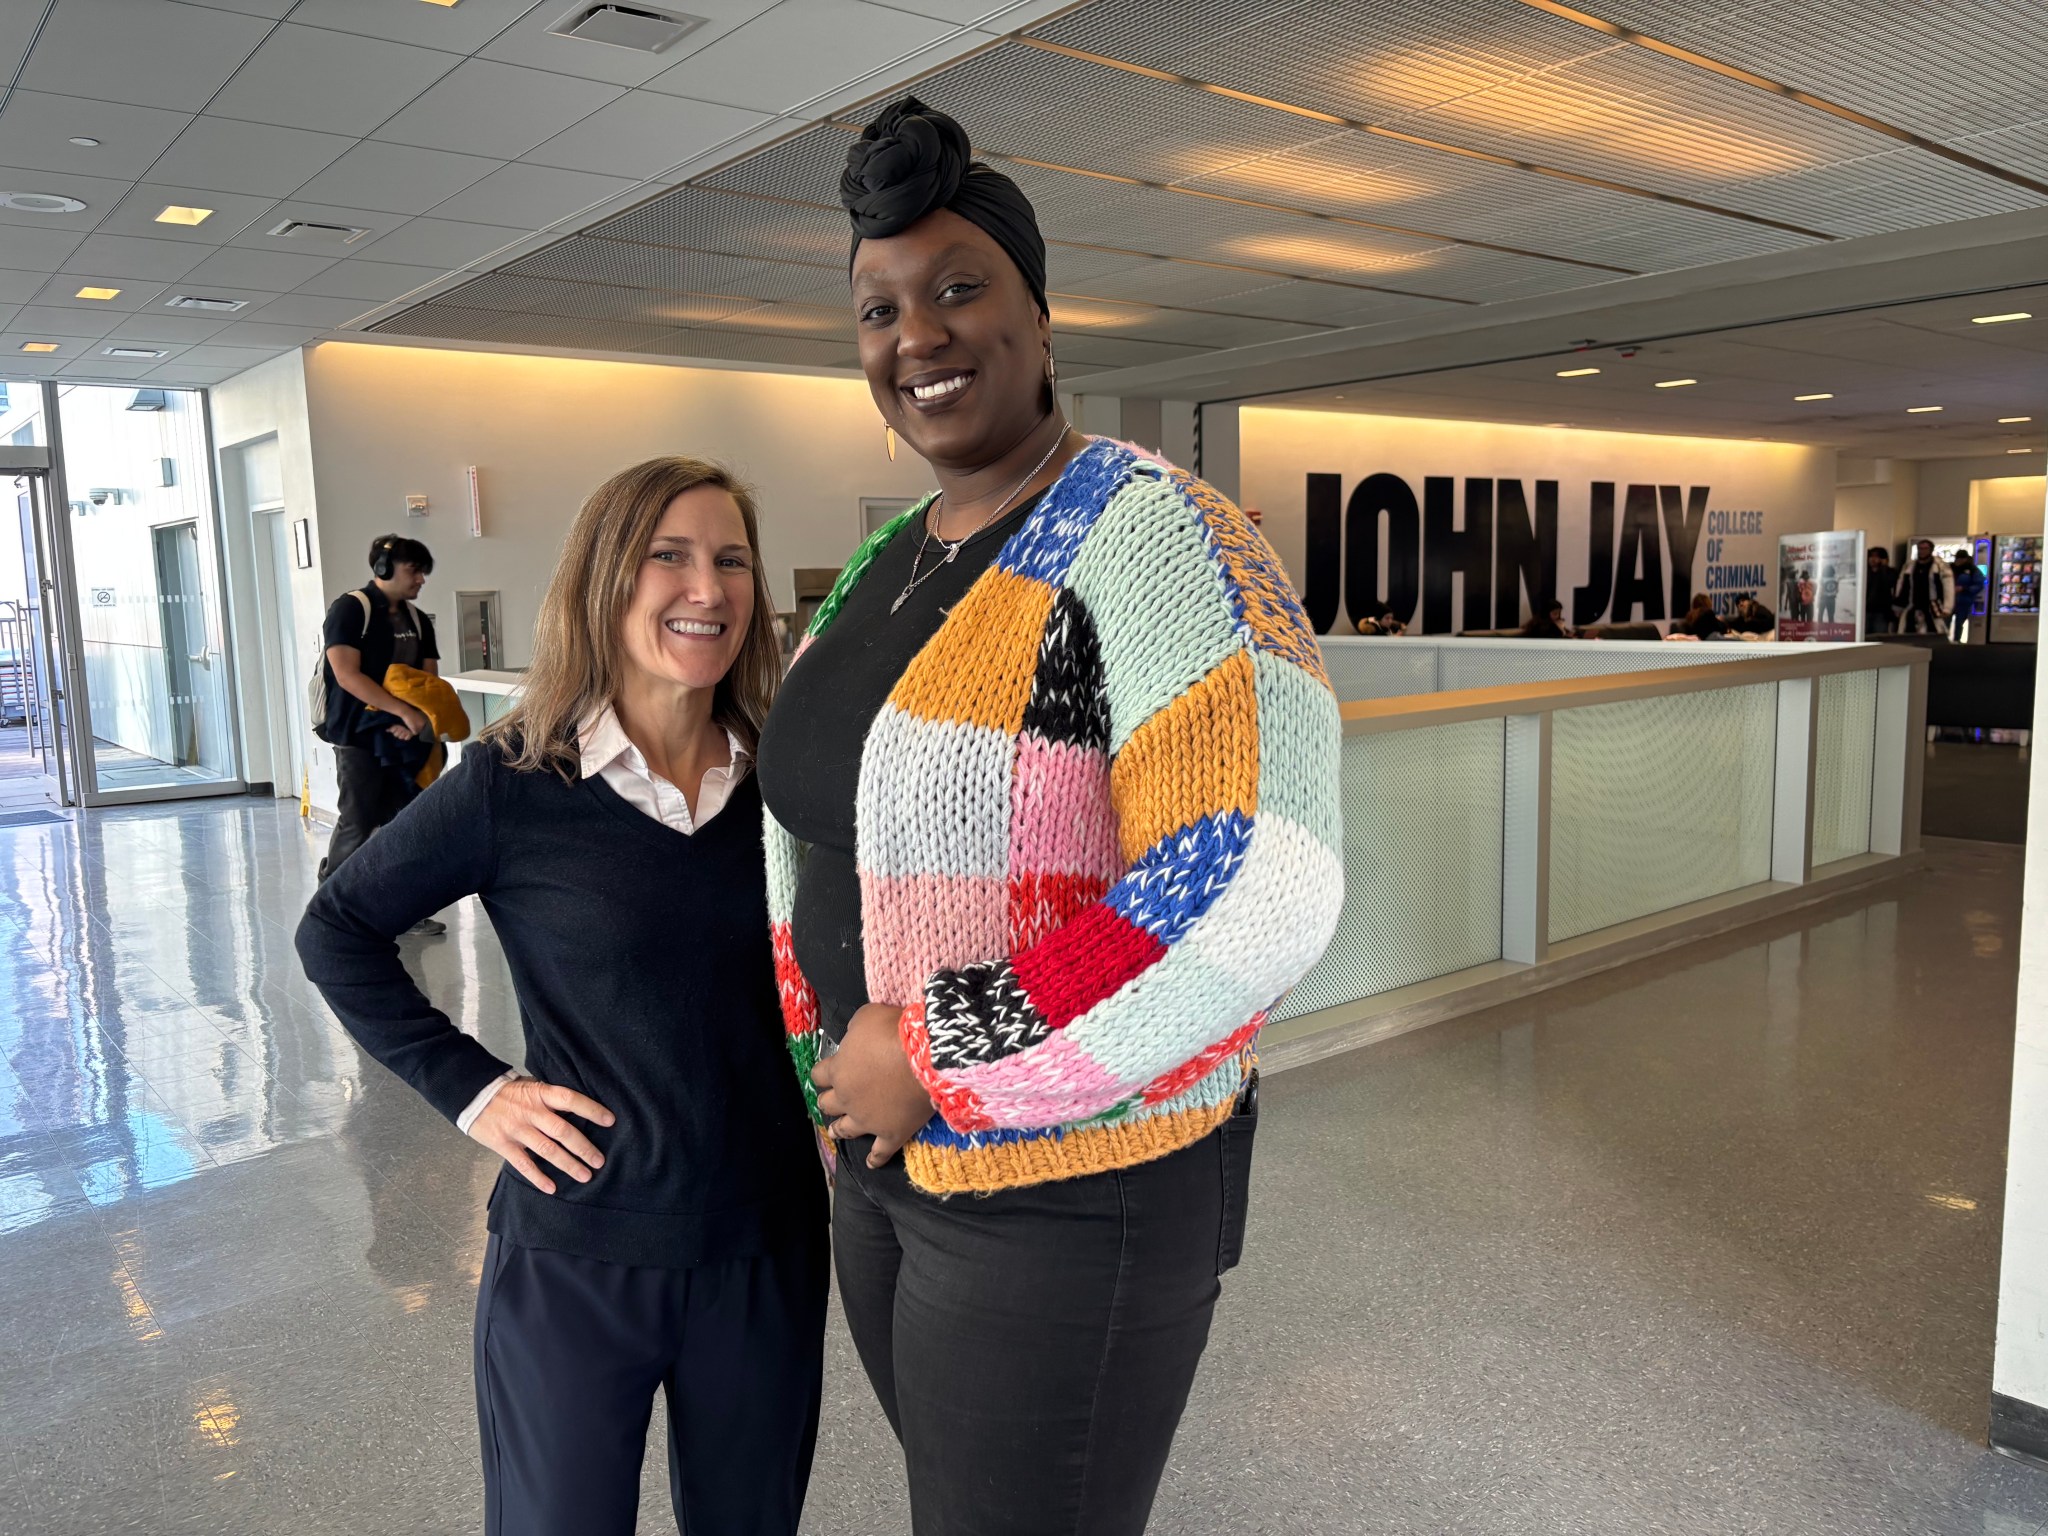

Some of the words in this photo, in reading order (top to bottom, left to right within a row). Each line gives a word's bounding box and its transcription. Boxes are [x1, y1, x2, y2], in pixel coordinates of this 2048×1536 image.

[1707, 510, 1763, 535] COLLEGE
[1300, 473, 1559, 636] JOHN
[1573, 482, 1710, 626] JAY
[1706, 538, 1723, 562] OF
[1705, 564, 1766, 590] CRIMINAL
